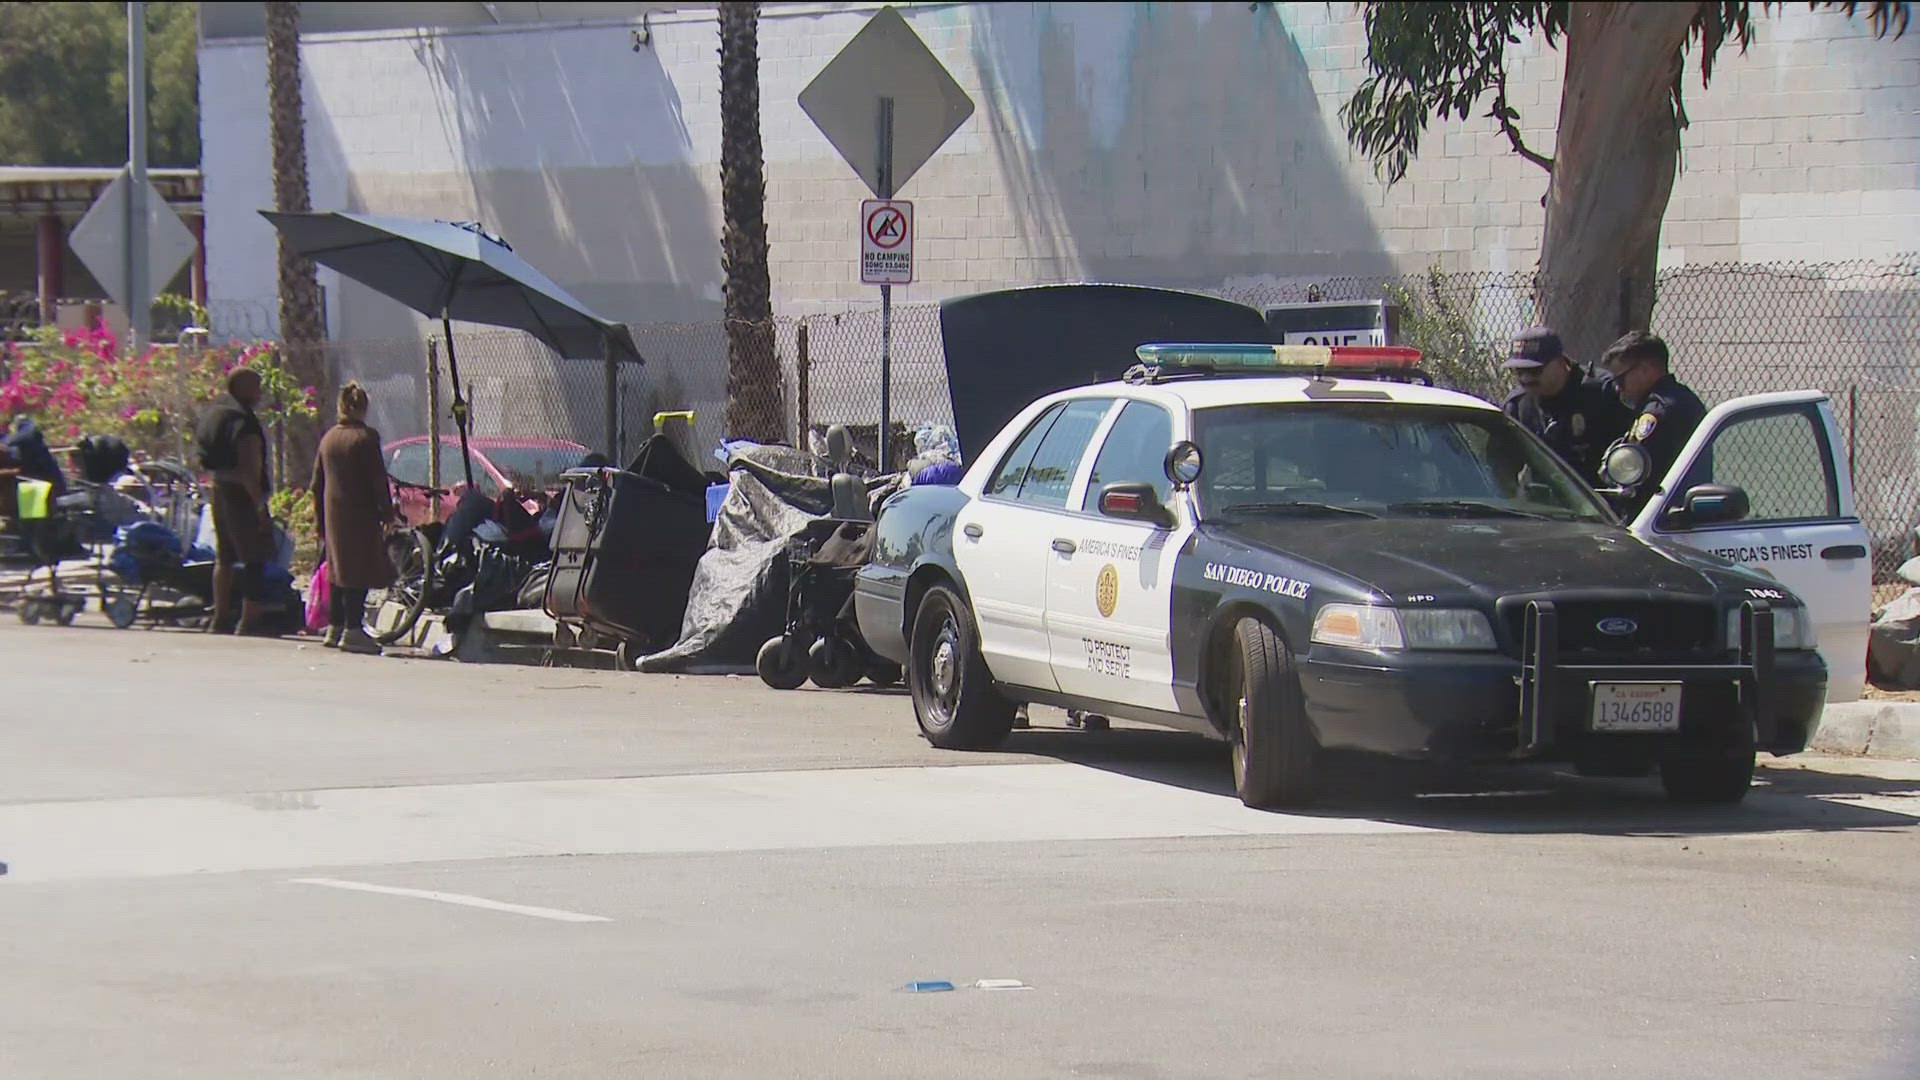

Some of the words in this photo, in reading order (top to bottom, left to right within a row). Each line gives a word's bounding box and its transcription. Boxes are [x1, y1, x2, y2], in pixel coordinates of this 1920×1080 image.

[865, 252, 875, 261] NO
[877, 252, 909, 262] CAMPING
[1771, 543, 1813, 560] FINEST
[1204, 562, 1228, 583] SAN
[1226, 566, 1264, 589] DIEGO
[1262, 574, 1311, 600] POLICE
[1082, 637, 1094, 653] TO
[1094, 640, 1131, 661] PROTECT
[1087, 656, 1103, 674] AND
[1105, 660, 1130, 679] SERVE
[1599, 701, 1674, 723] 1346588
